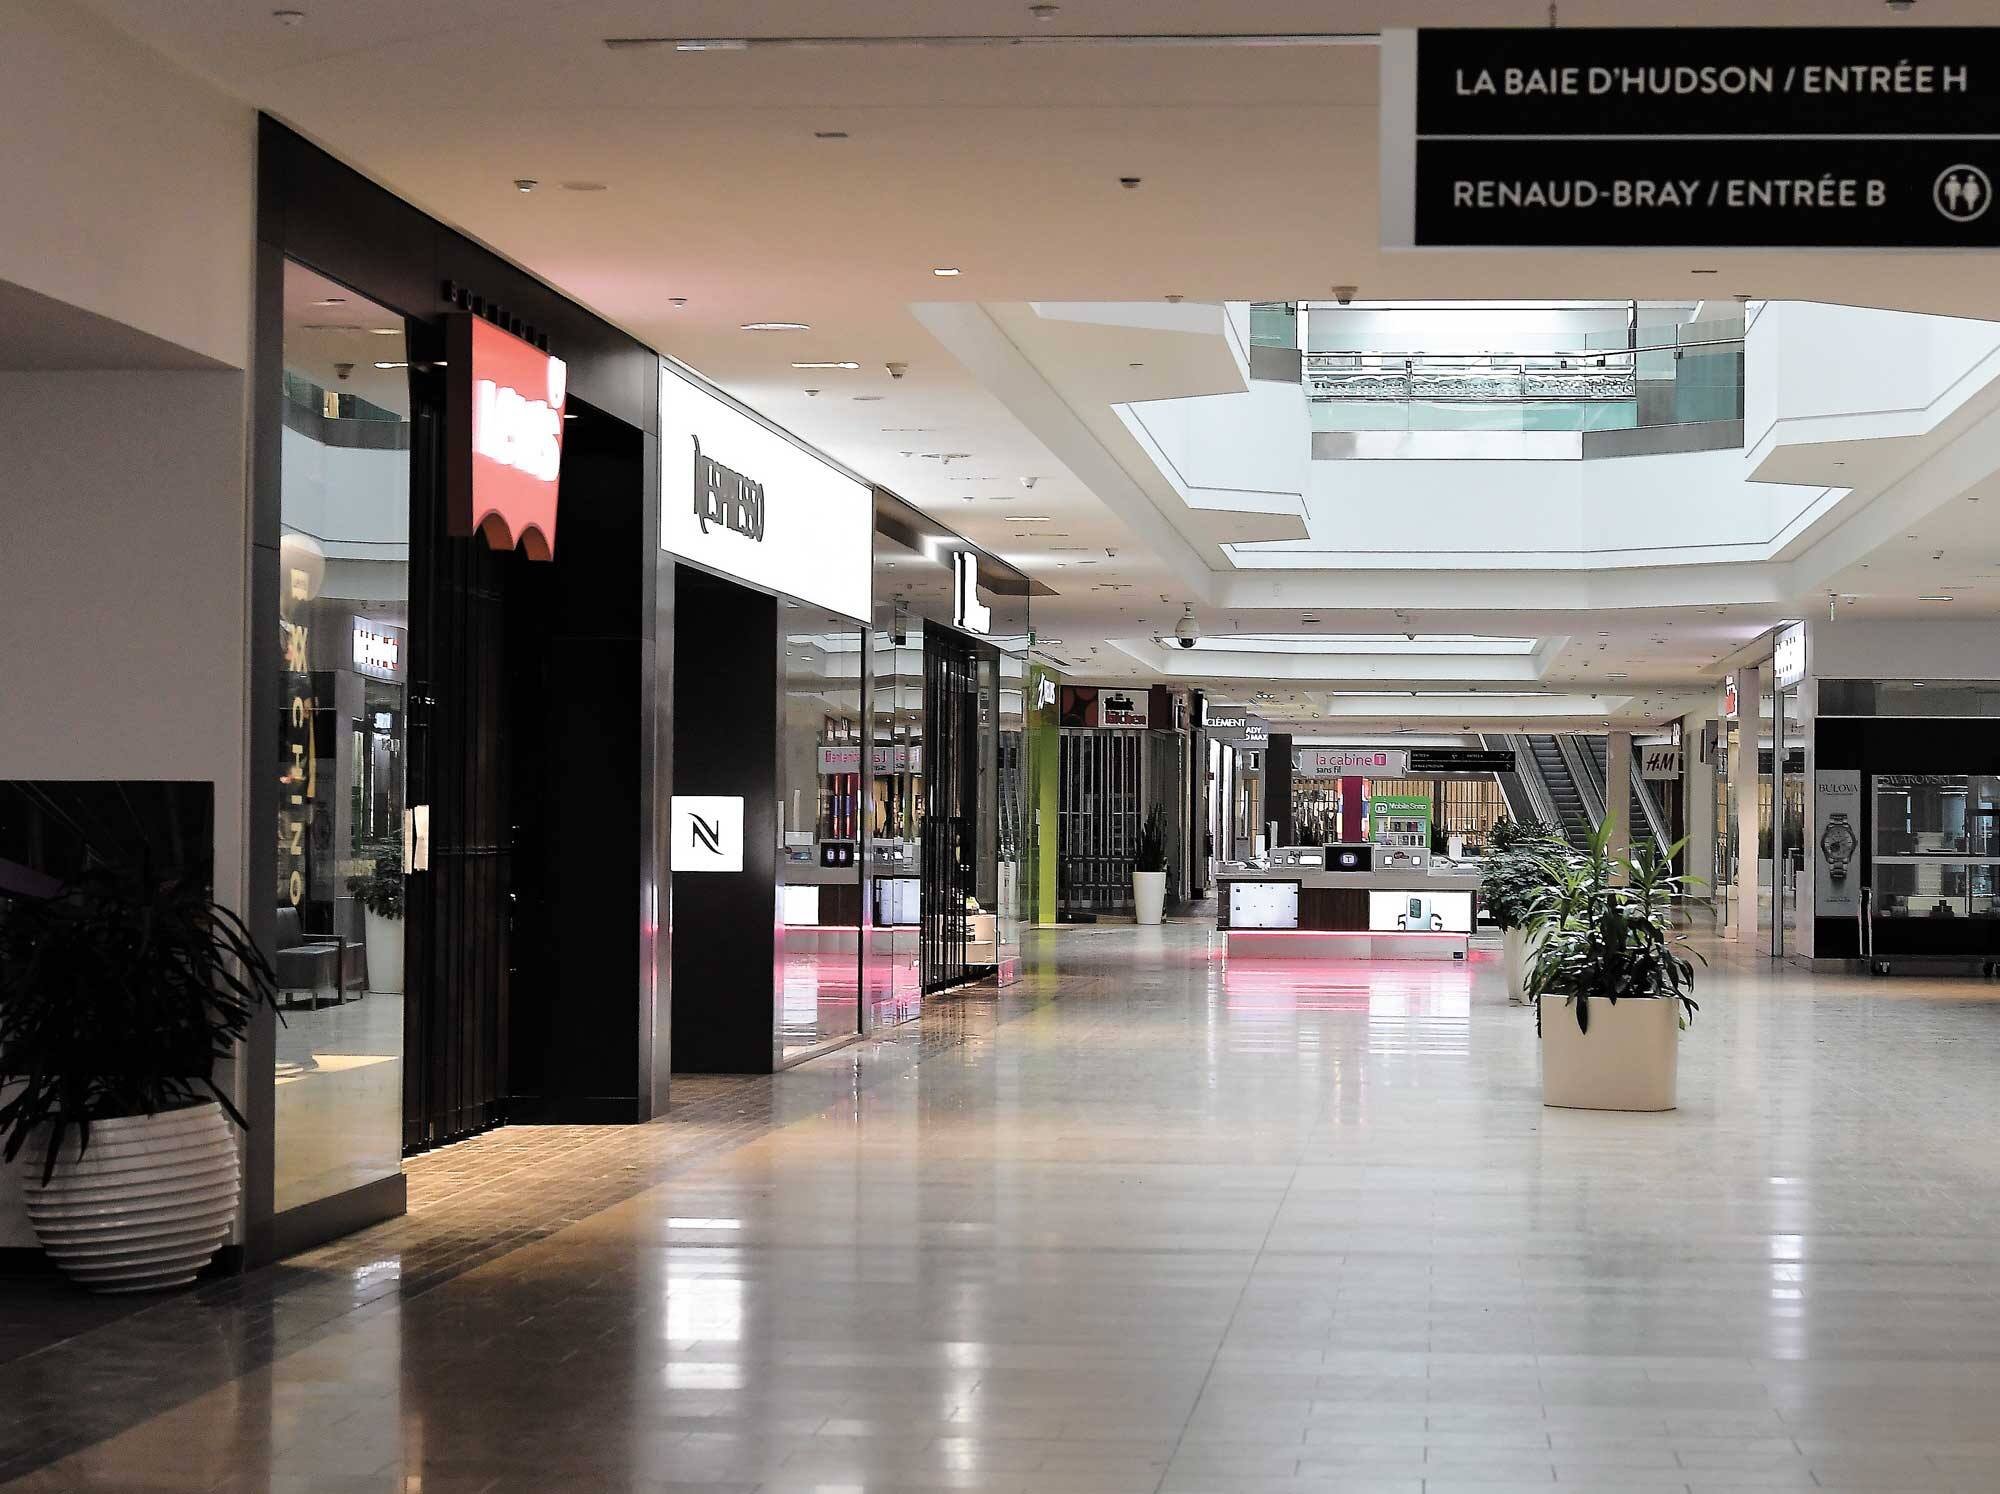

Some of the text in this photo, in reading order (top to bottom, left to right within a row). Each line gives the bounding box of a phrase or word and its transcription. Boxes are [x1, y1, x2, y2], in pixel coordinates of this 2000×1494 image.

[1456, 69, 1497, 95] LA
[1505, 67, 1579, 95] BAIE
[1783, 67, 1796, 92] /
[1803, 59, 1934, 93] ENTRÉE
[1943, 66, 1967, 92] H
[1454, 173, 1886, 208] RENAUD-BRAY / ENTRÉE B
[1207, 717, 1246, 727] CLÉMENT
[1316, 753, 1326, 766] la
[1329, 753, 1372, 766] cabine
[1646, 752, 1675, 772] H&M
[1819, 784, 1859, 793] BULOVA
[688, 812, 725, 855] N
